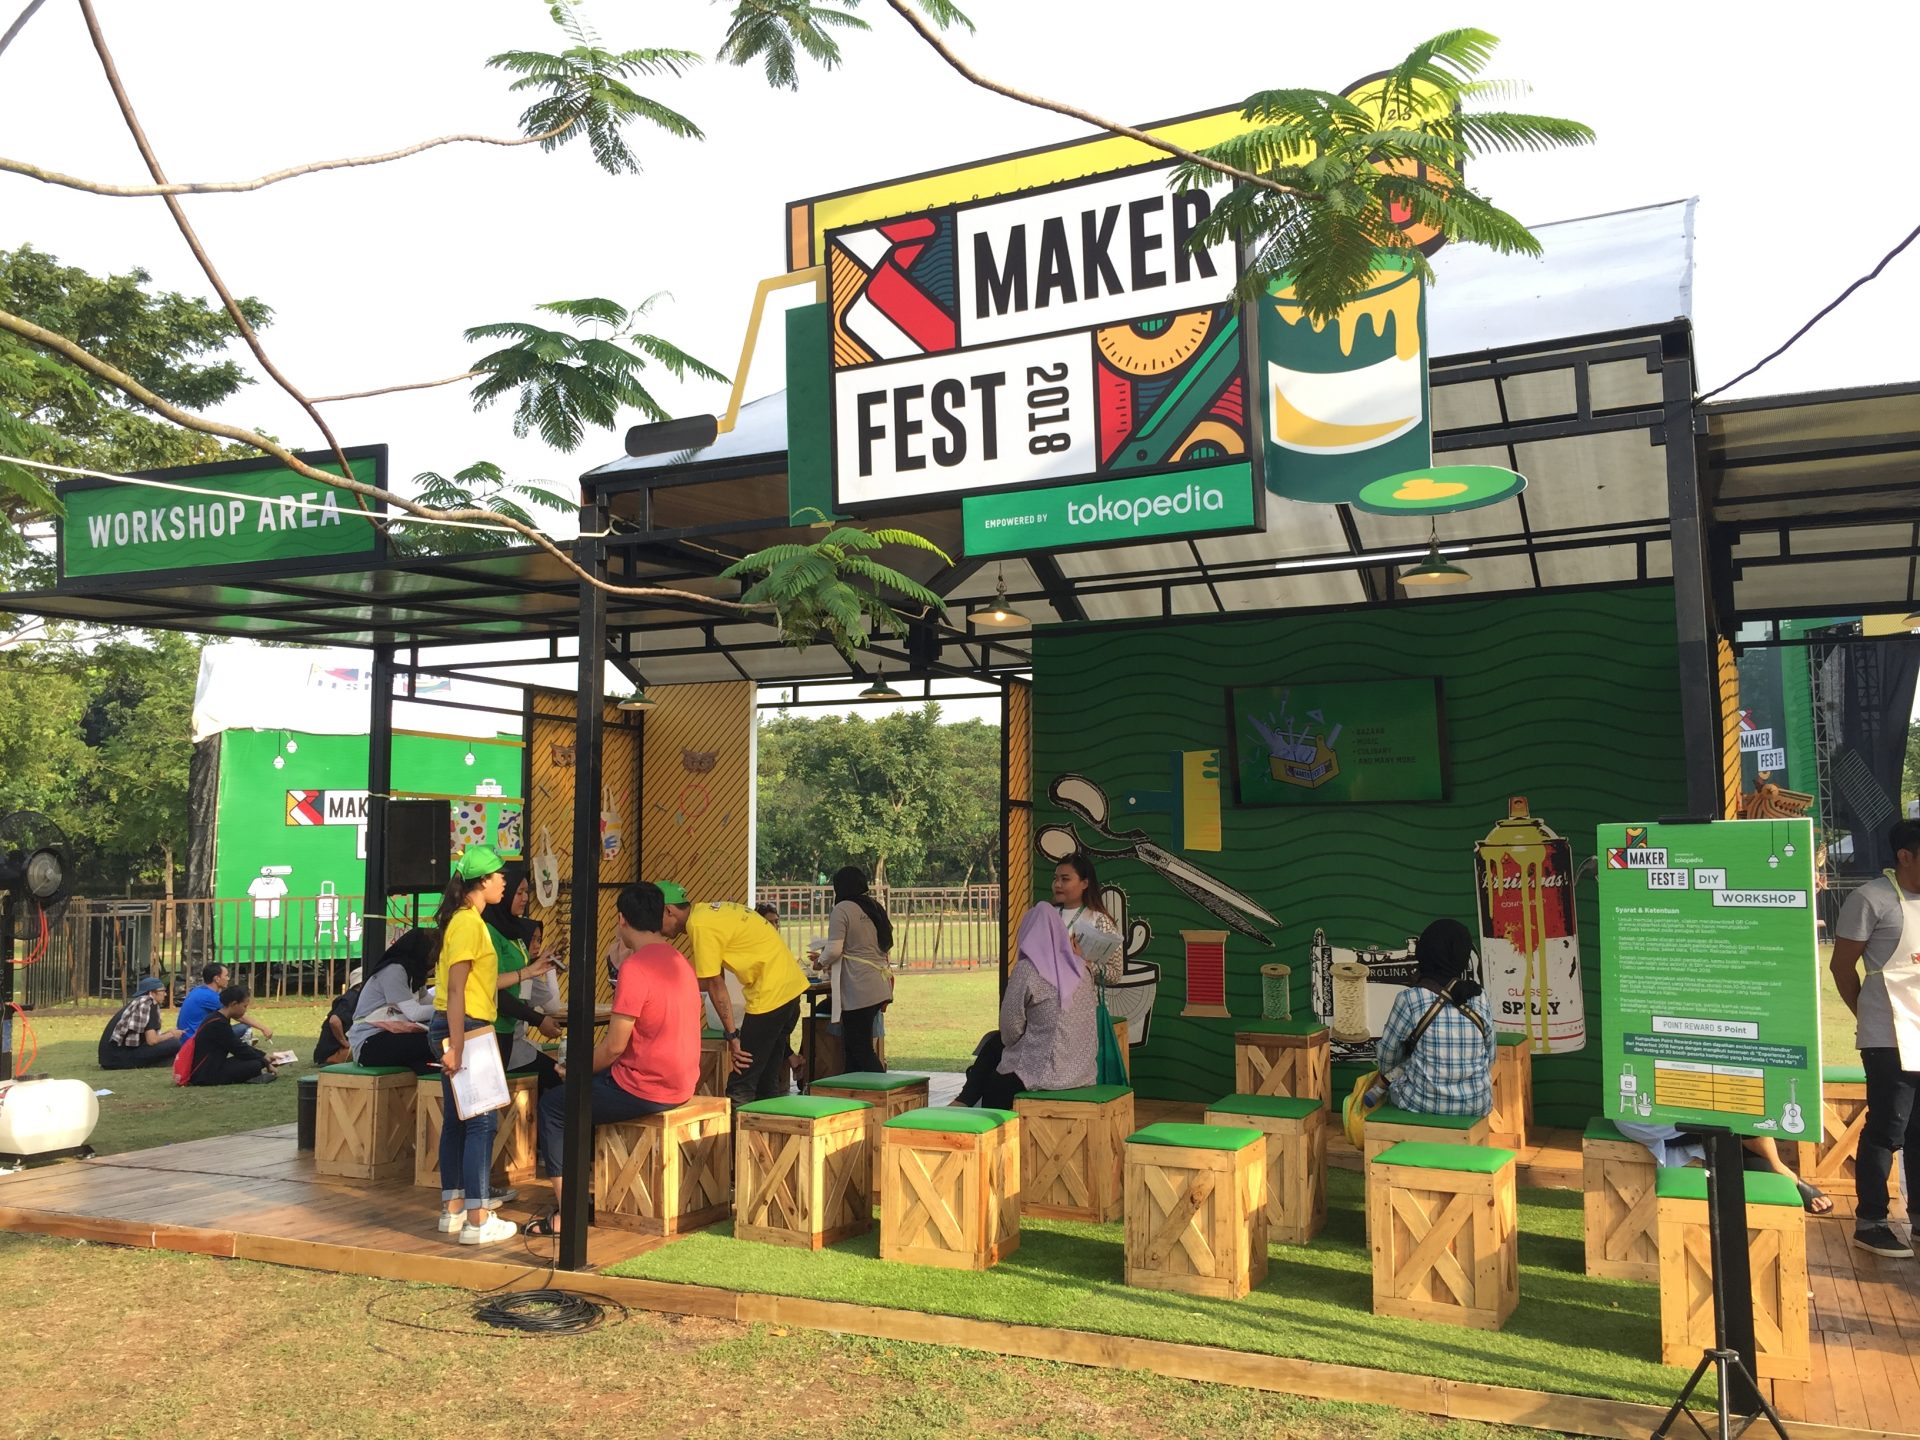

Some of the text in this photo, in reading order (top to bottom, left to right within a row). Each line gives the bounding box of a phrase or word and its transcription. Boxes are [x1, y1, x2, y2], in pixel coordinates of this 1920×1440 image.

[973, 187, 1218, 320] MAKER
[857, 361, 1071, 477] FEST 2018
[984, 485, 1224, 530] EMPOWERED BY tokopedia
[88, 491, 341, 549] WORKSHOP AREA
[1741, 733, 1770, 748] MAKER
[1760, 753, 1778, 767] FEST
[329, 797, 369, 818] MAK
[1629, 852, 1665, 865] MAKER
[1651, 872, 1675, 886] FEST
[1699, 875, 1719, 884] DIY
[1722, 893, 1796, 904] WORKSHOP
[1615, 906, 1637, 914] Syarat
[1507, 987, 1553, 997] CLASSC
[1663, 1020, 1683, 1030] POINT
[1684, 1022, 1715, 1032] REWARD
[1724, 1025, 1746, 1034] Point
